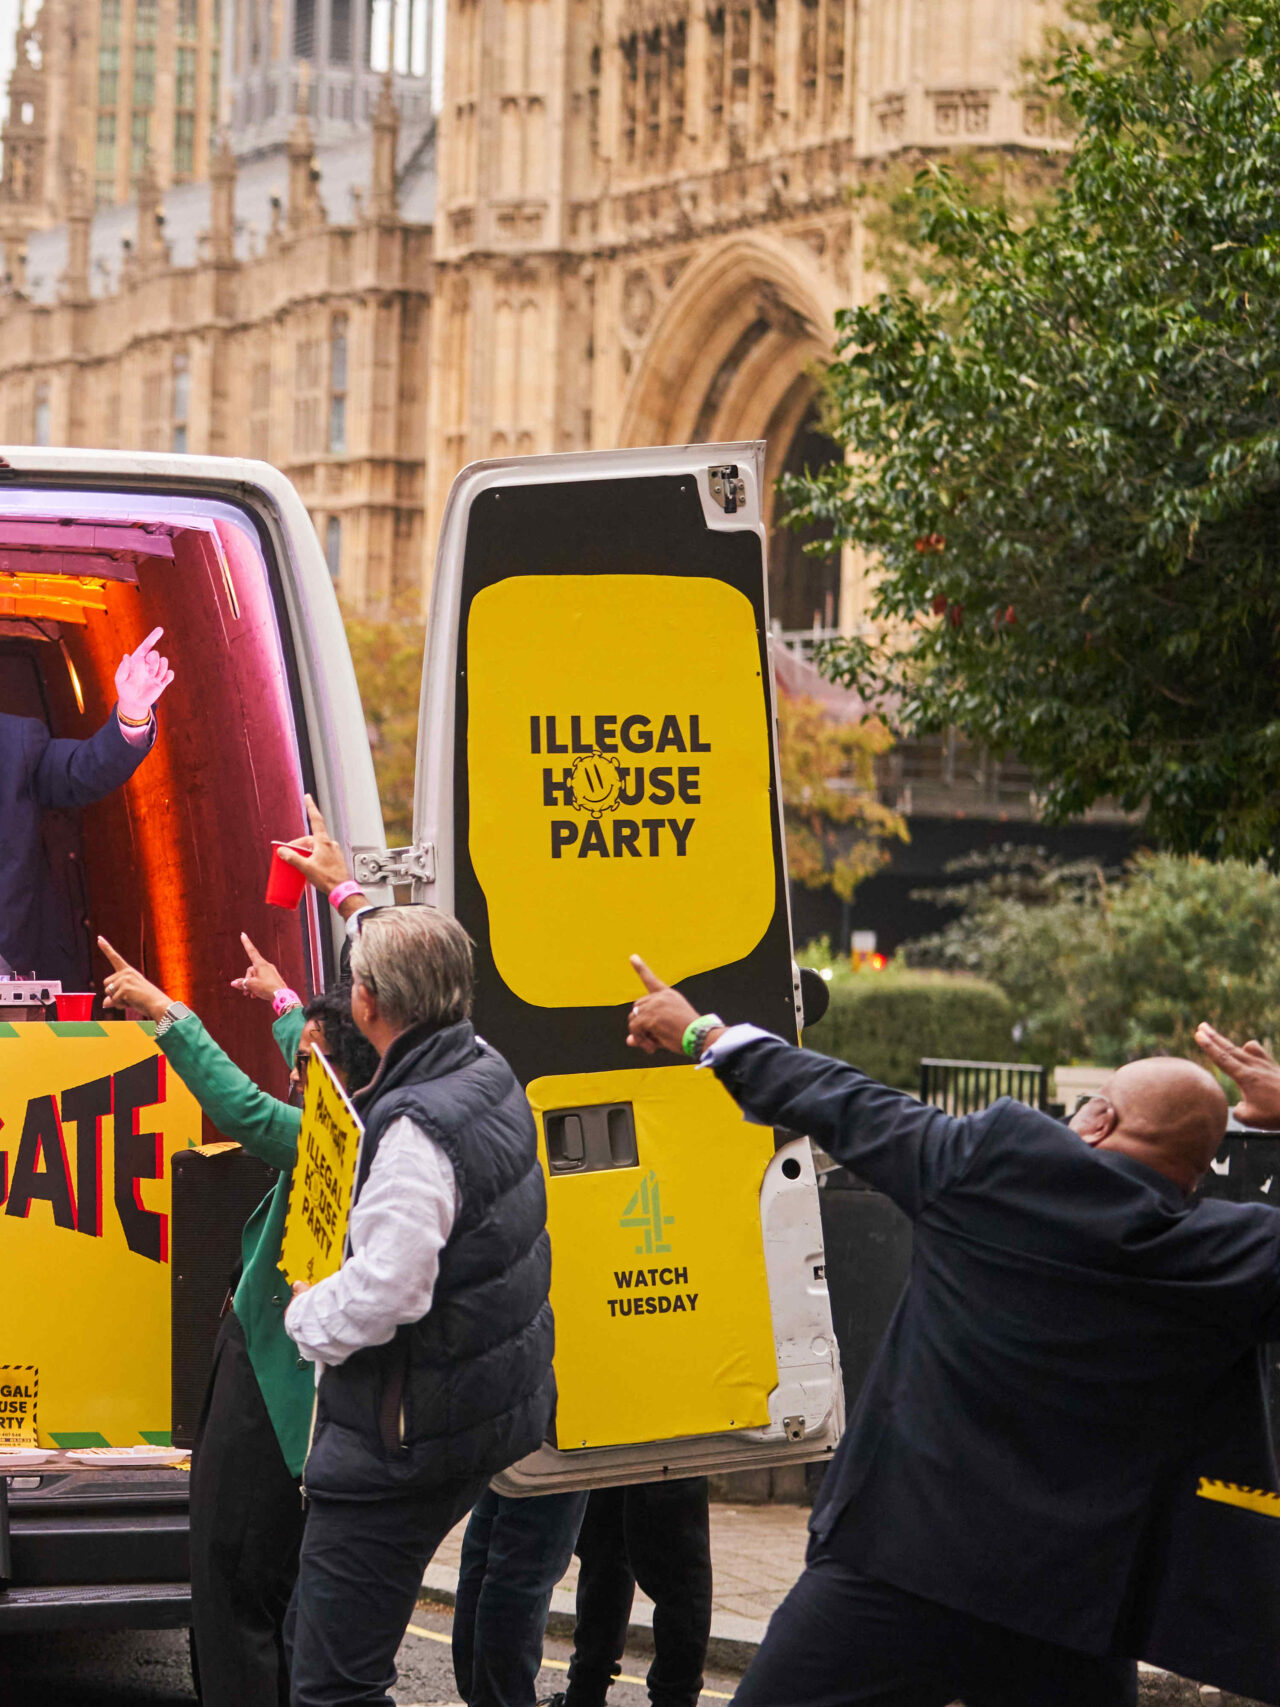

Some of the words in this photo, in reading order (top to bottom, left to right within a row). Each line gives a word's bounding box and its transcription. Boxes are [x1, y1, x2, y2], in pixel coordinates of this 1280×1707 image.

[530, 715, 711, 754] ILLEGAL
[551, 818, 696, 859] PARTY
[306, 1131, 342, 1211] ILLEGAL
[301, 1196, 333, 1260] PARTY
[613, 1266, 689, 1289] WATCH
[607, 1293, 699, 1318] TUESDAY
